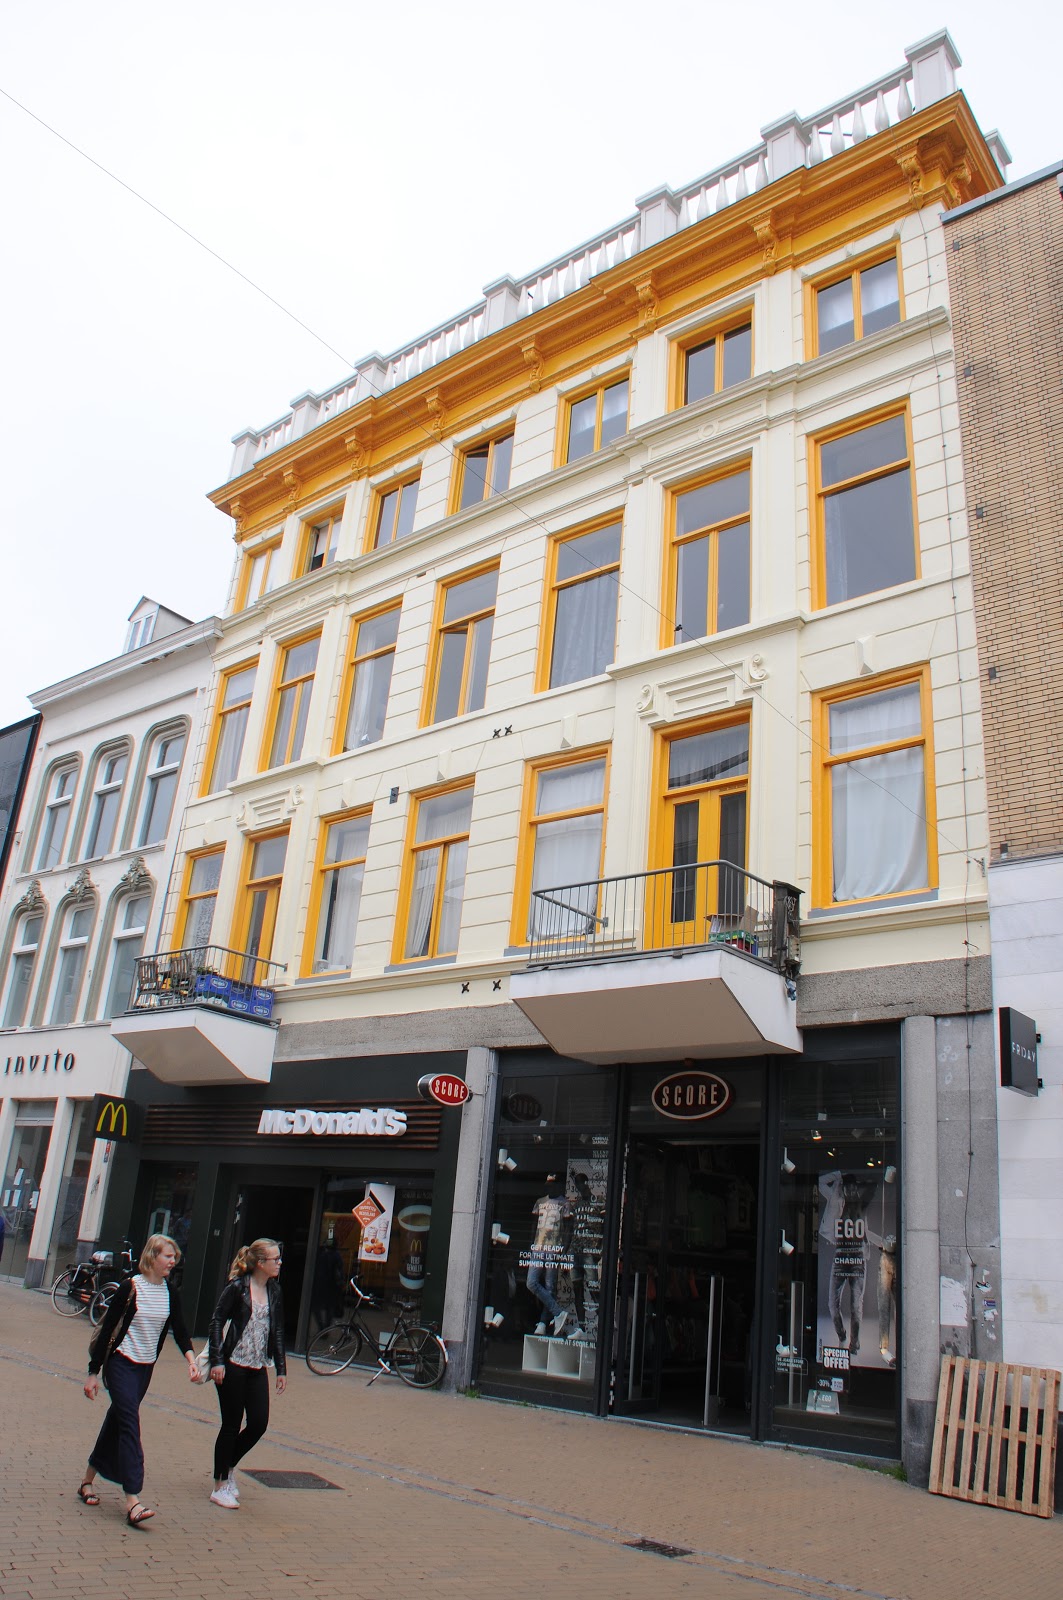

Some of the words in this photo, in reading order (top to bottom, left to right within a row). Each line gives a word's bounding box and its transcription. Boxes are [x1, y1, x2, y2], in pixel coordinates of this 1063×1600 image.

[1011, 1041, 1036, 1063] FRIDAY
[434, 1079, 465, 1100] SCORE
[661, 1083, 719, 1107] SCORE
[256, 1107, 408, 1137] McDonald's
[834, 1218, 865, 1239] EGO
[546, 1253, 574, 1262] ULTIMATE
[823, 1348, 850, 1358] SPECIAL
[823, 1356, 850, 1370] OFFER
[821, 1394, 832, 1402] EGO
